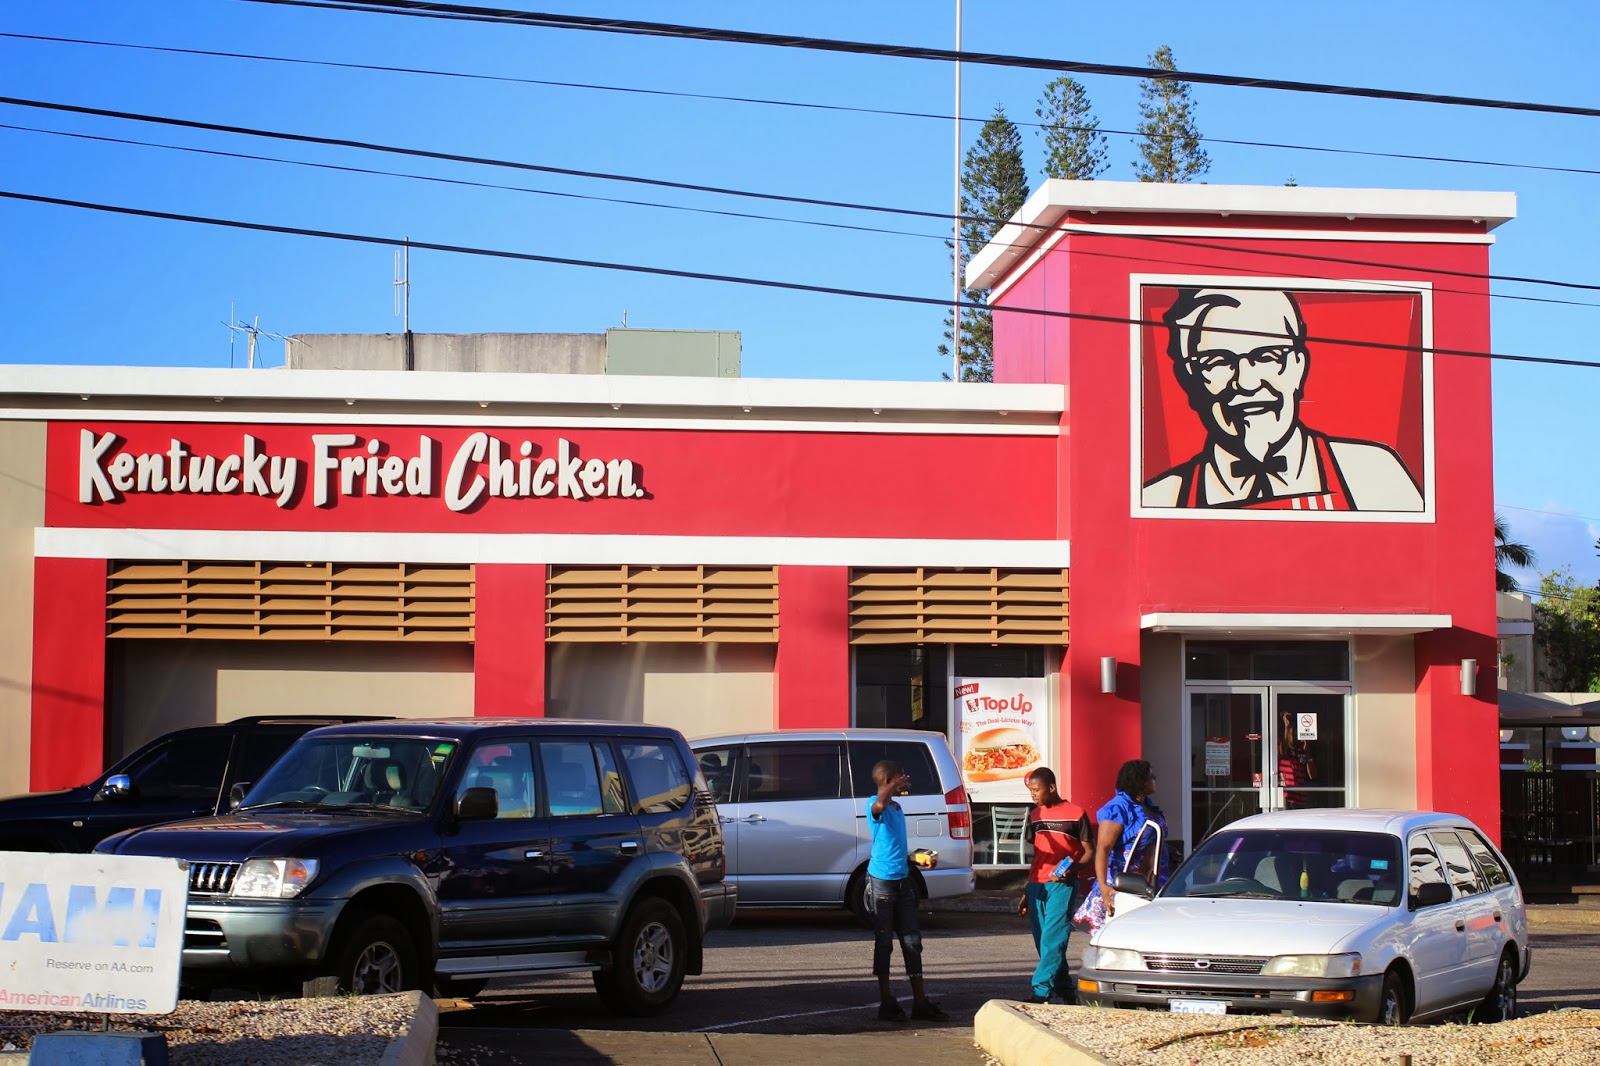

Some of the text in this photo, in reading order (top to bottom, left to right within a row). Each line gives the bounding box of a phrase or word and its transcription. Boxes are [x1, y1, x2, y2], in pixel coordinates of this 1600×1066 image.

[79, 428, 645, 512] Kentucky Fried Chicken.
[955, 684, 975, 697] New!
[979, 693, 1033, 715] Top Up
[0, 881, 162, 948] AMI
[46, 958, 154, 974] Reserve on AA.com
